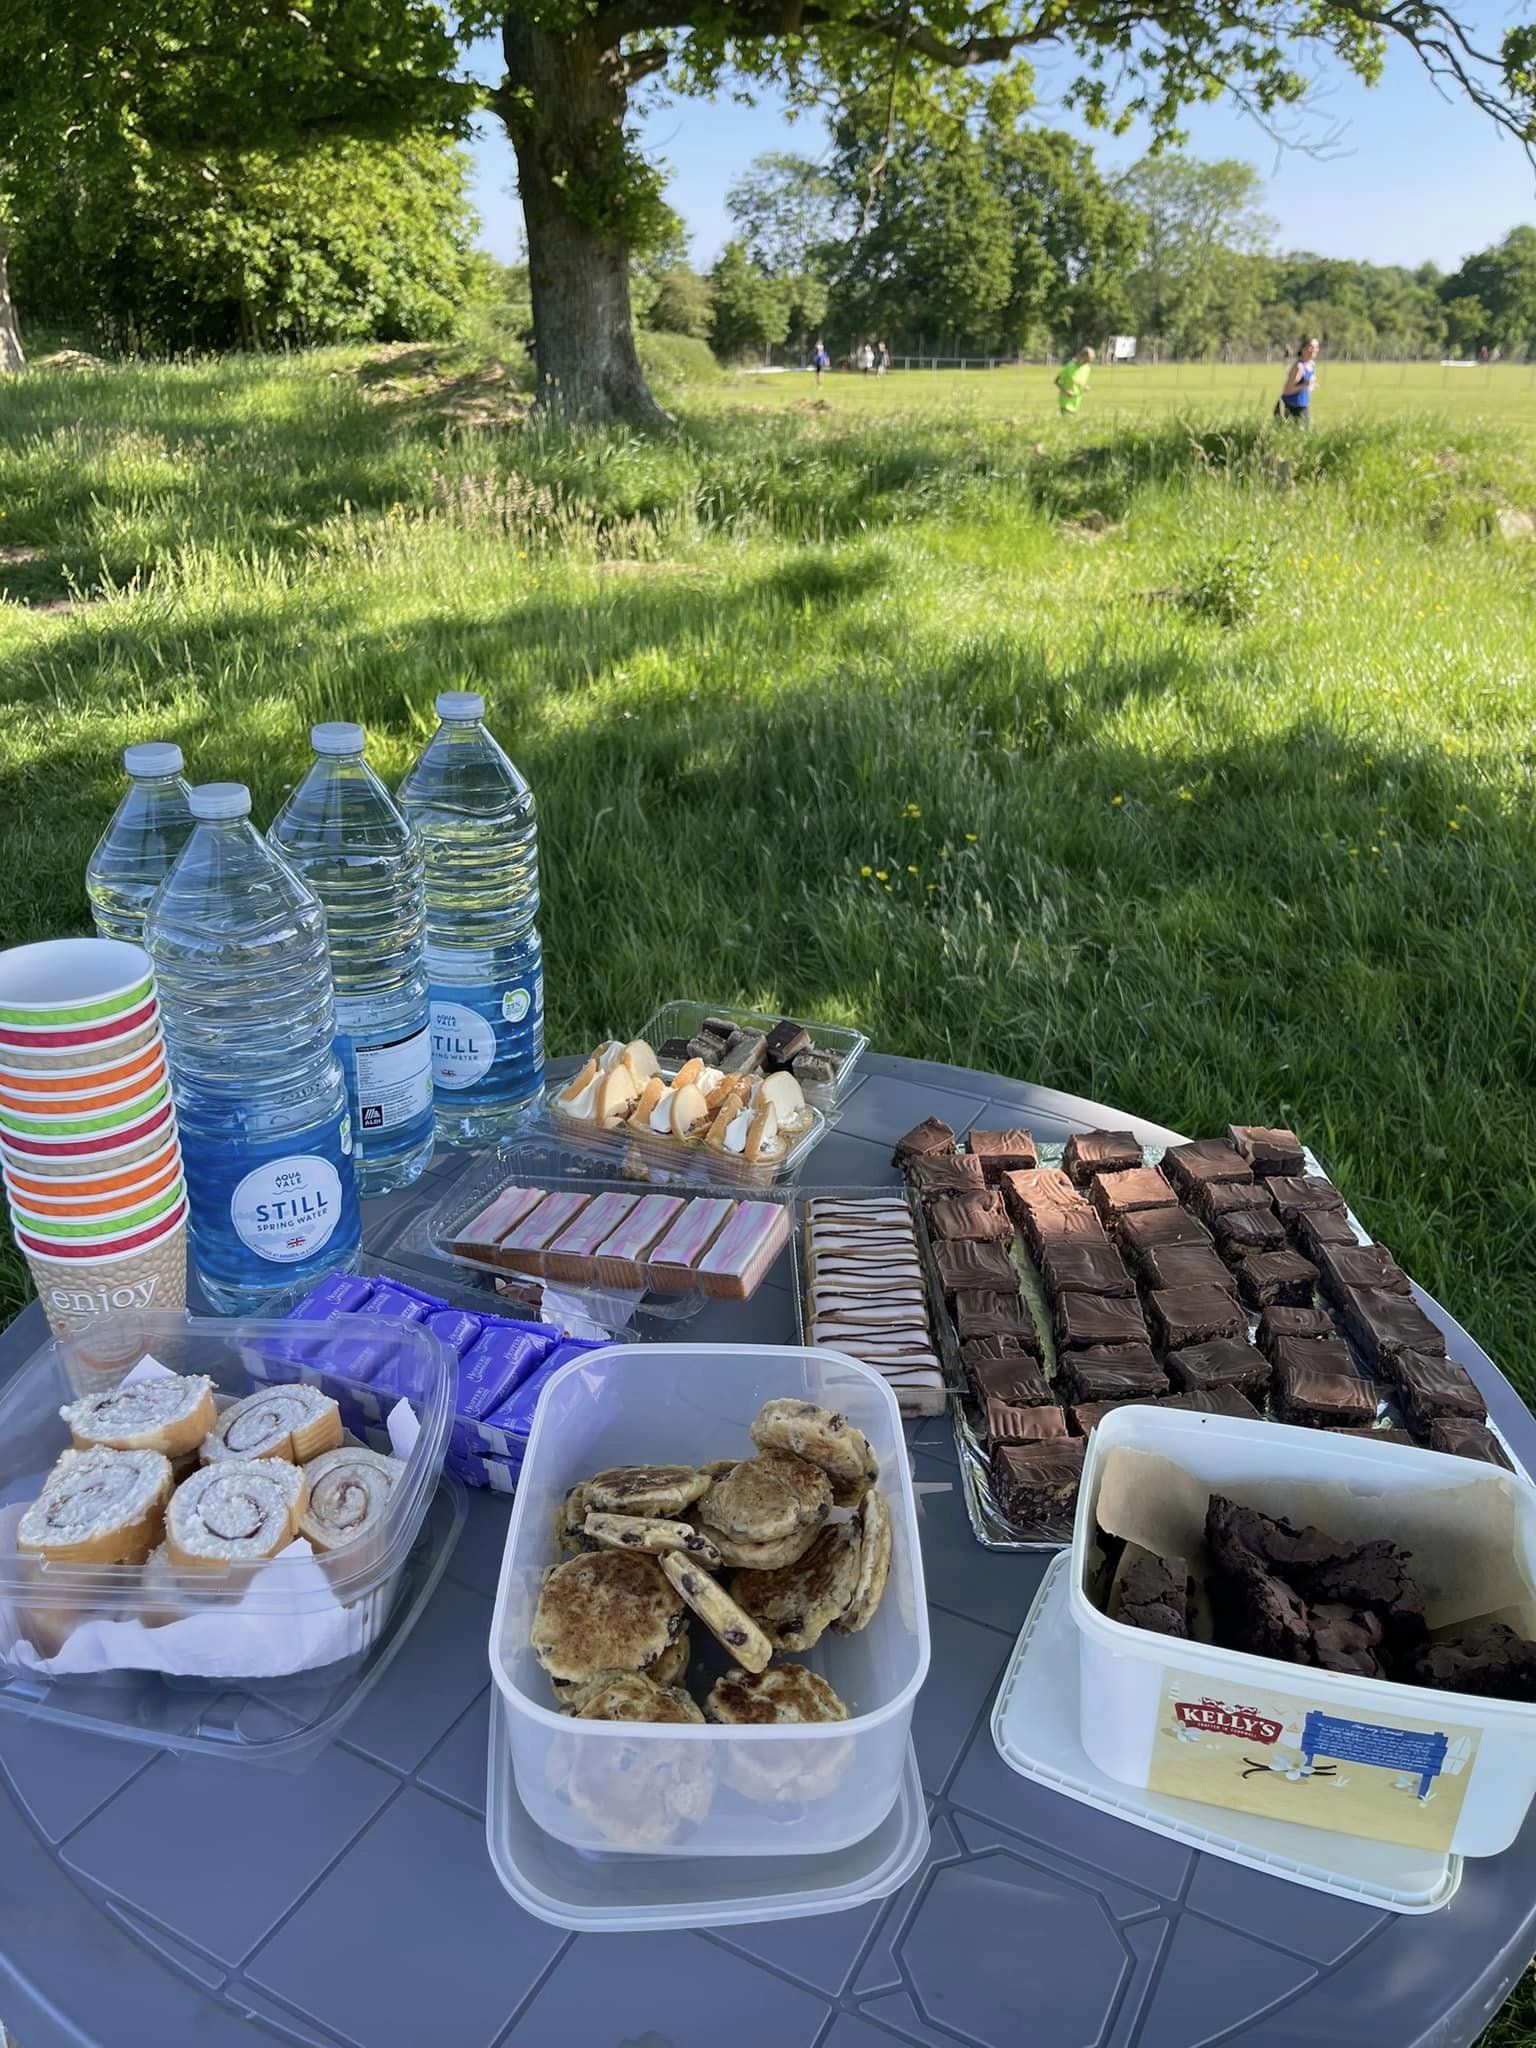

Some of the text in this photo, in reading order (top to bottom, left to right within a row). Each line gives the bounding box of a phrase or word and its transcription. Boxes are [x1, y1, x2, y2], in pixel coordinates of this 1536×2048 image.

[432, 1035, 479, 1053] TILL
[364, 1118, 382, 1126] ALDI
[275, 1171, 301, 1182] AQUA
[275, 1176, 302, 1188] VALE
[256, 1191, 328, 1222] STILL
[256, 1207, 328, 1232] SPRING WATER
[51, 1272, 160, 1314] enjoy
[1182, 1707, 1276, 1737] KELLY'S
